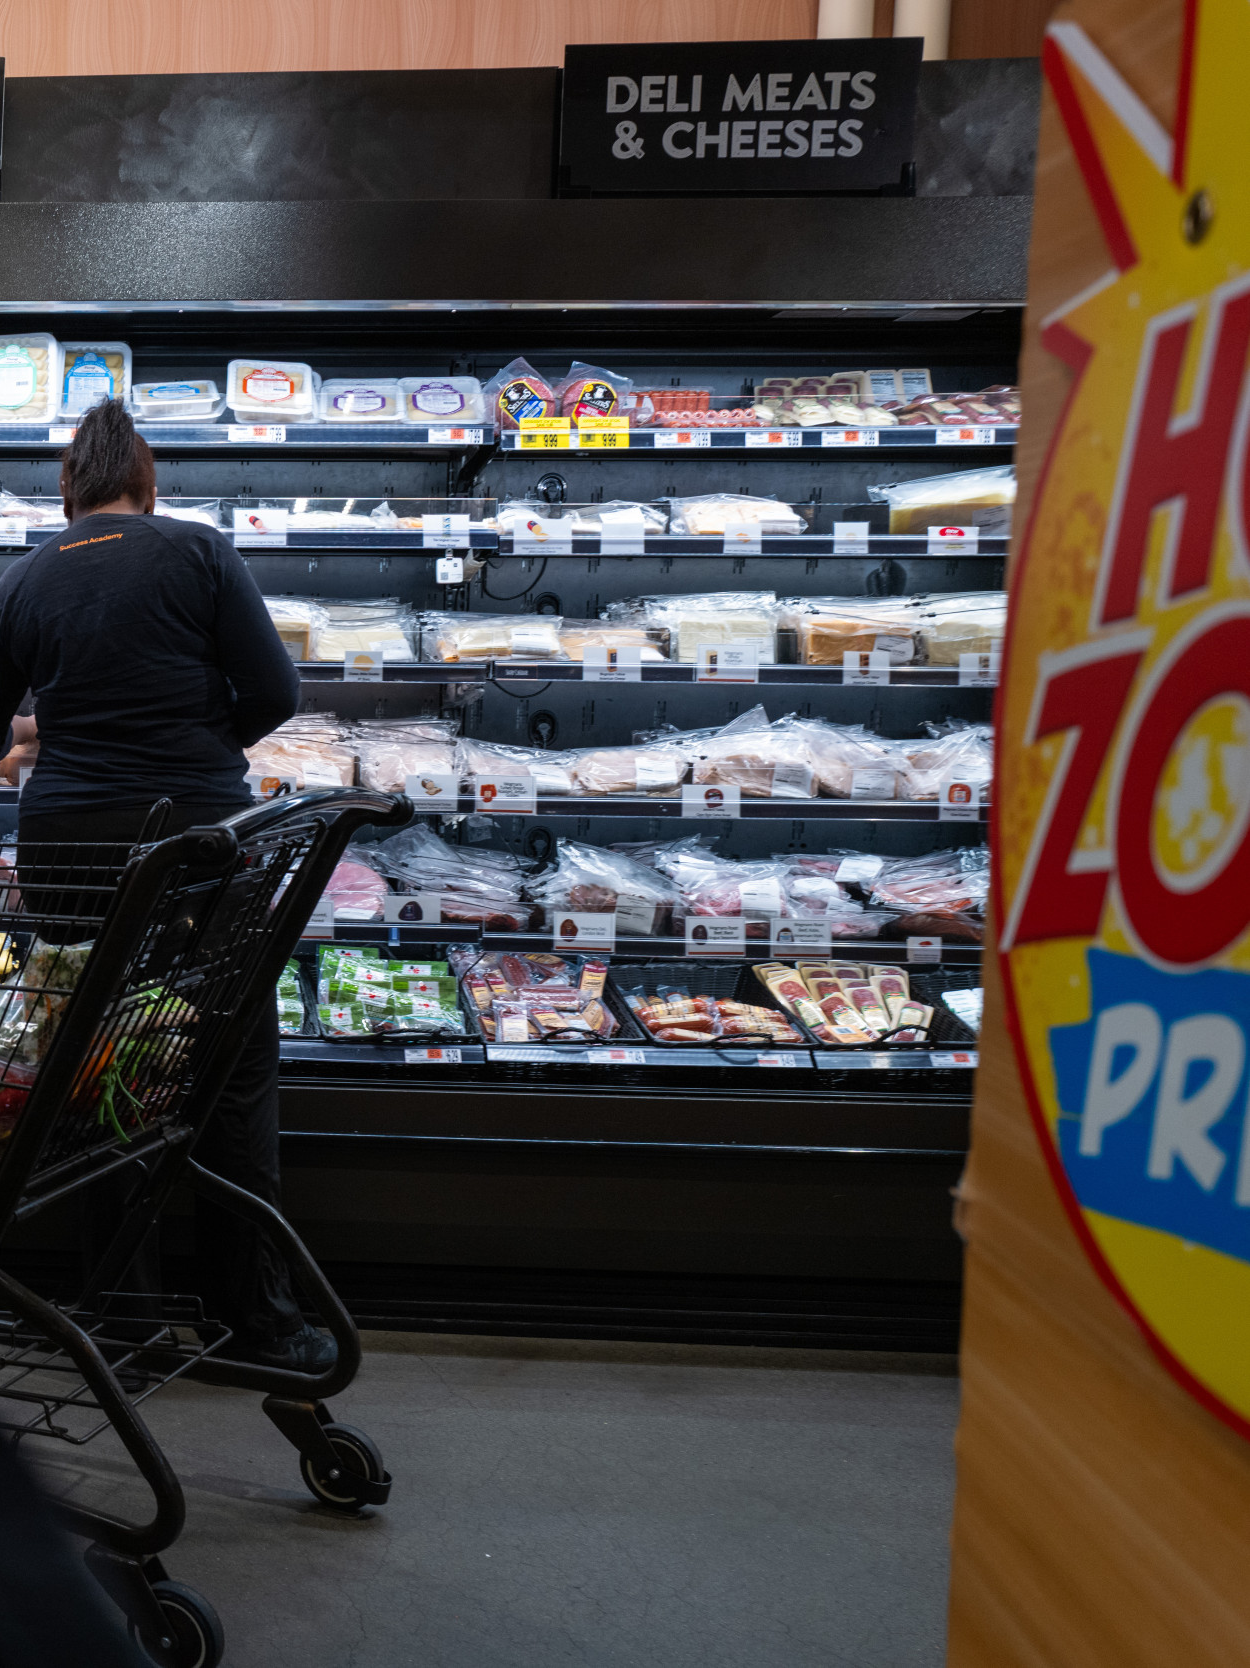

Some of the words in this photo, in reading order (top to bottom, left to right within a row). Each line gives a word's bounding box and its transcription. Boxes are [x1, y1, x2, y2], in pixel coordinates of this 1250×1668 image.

[606, 75, 703, 113] DELI
[722, 71, 876, 112] MEATS
[611, 120, 645, 159] &
[662, 118, 864, 159] CHEESES
[1092, 272, 1250, 634] H
[60, 540, 88, 552] Success
[89, 533, 123, 544] Academy
